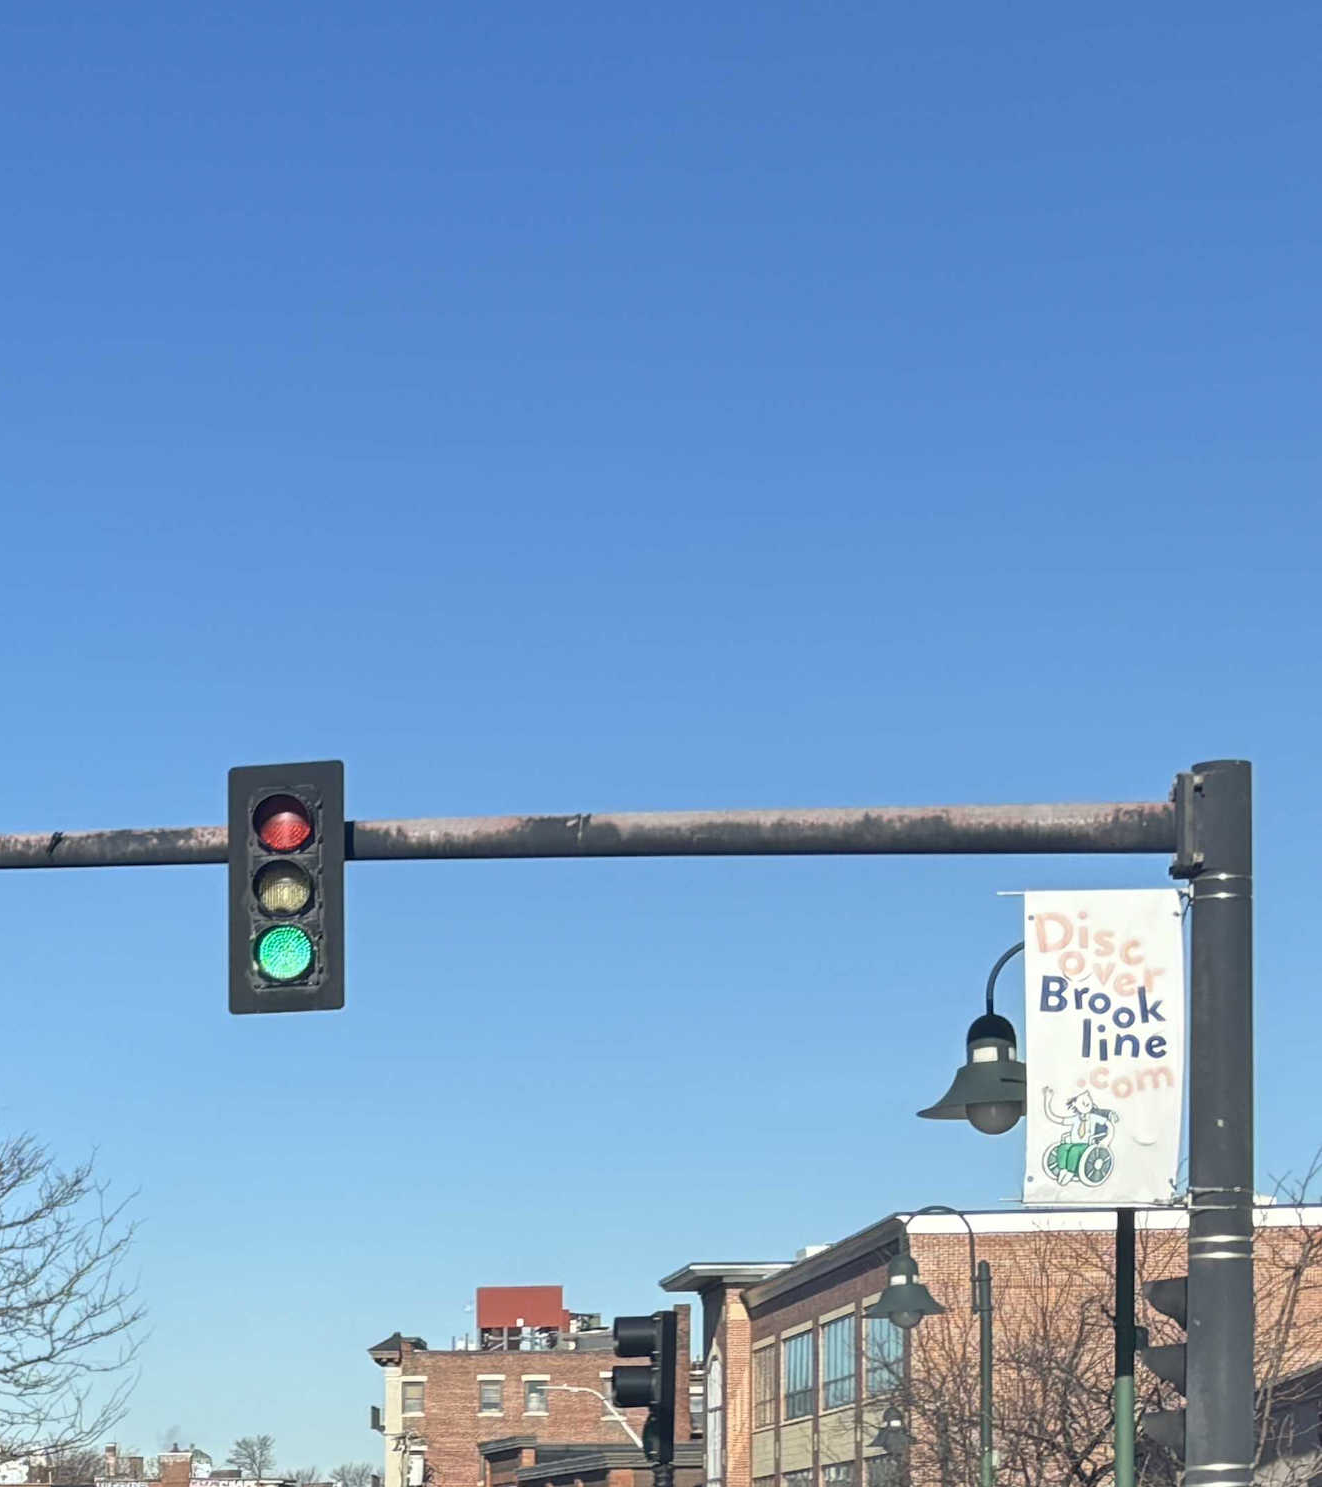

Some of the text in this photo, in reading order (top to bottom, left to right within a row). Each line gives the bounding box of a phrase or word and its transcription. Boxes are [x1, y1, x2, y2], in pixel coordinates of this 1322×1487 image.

[1034, 911, 1144, 965] Disc
[1058, 951, 1166, 998] over
[1039, 975, 1166, 1029] Brook
[1081, 1018, 1167, 1061] line
[1076, 1063, 1174, 1099] .com
